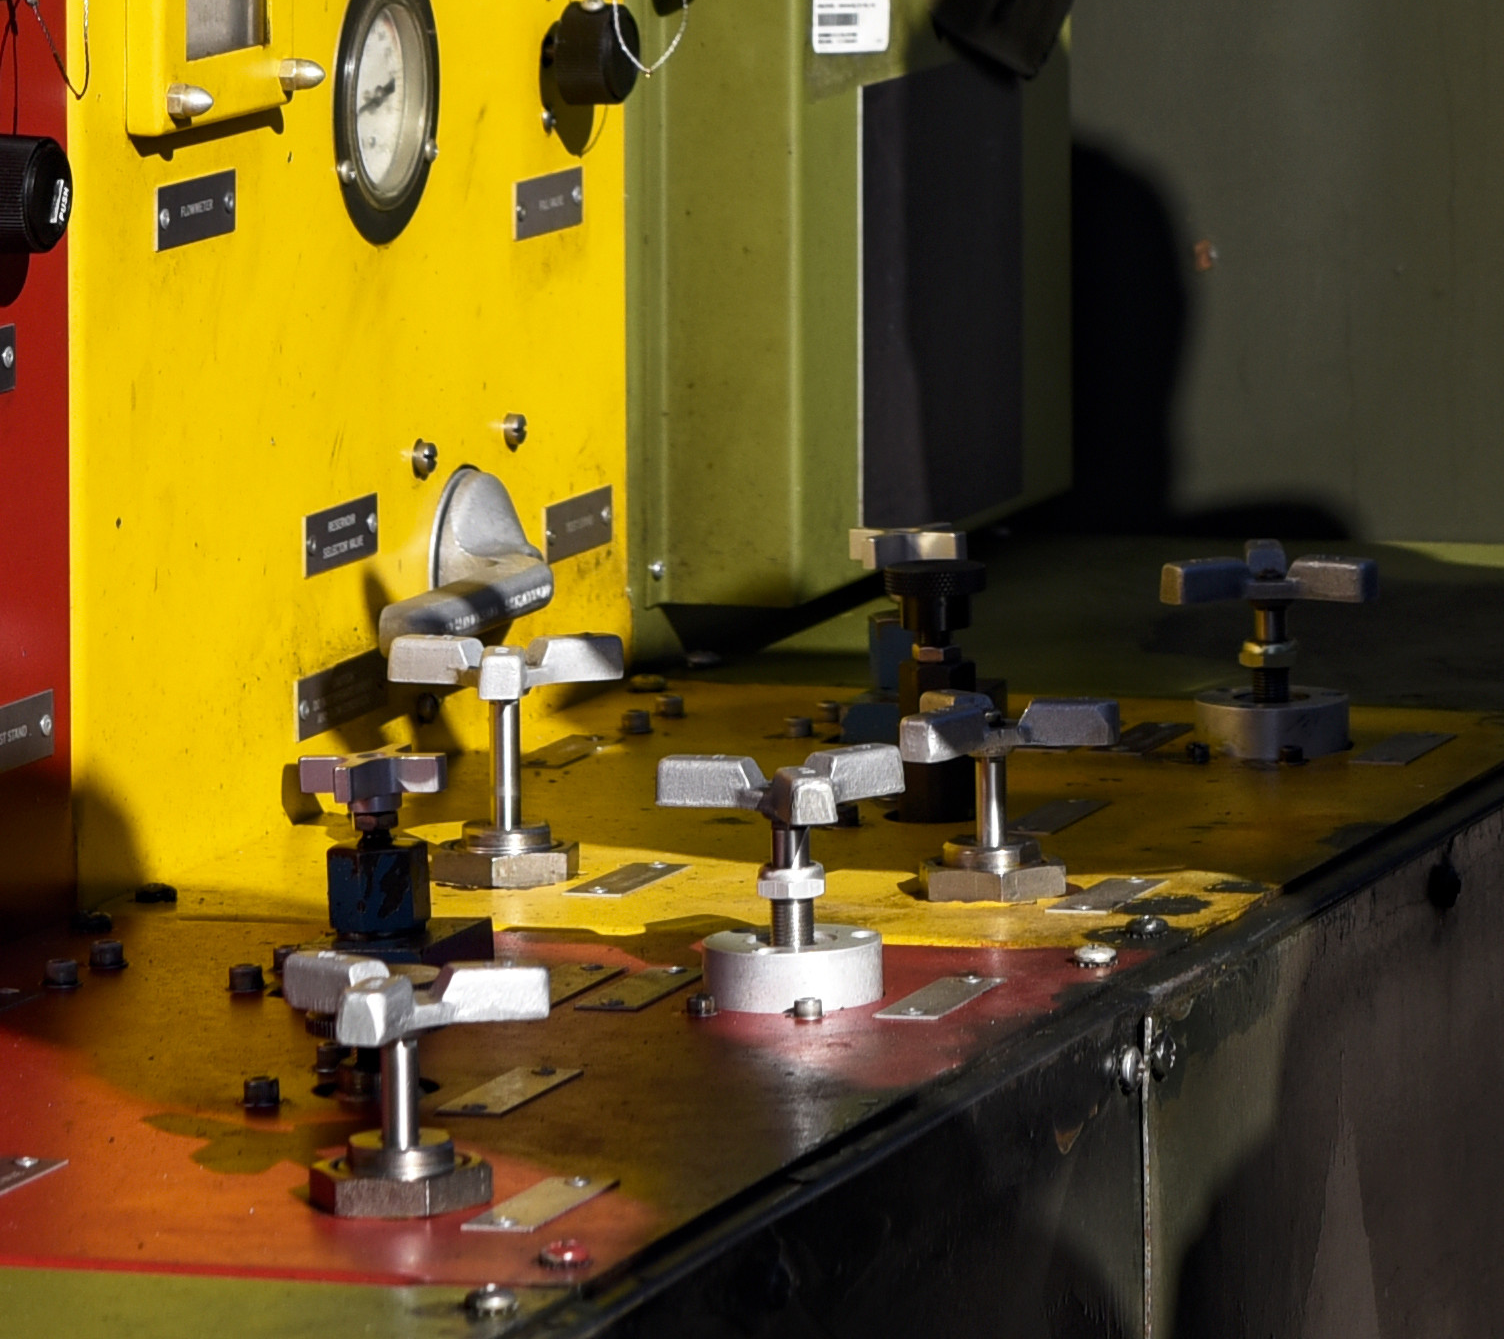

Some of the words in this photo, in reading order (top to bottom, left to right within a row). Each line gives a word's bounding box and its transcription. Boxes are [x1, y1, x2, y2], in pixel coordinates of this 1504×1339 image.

[58, 186, 70, 222] PUSH
[179, 197, 214, 218] FLOWMETER
[322, 539, 349, 560] SELECTOR
[349, 533, 365, 551] VALVE
[6, 724, 29, 744] STAND
